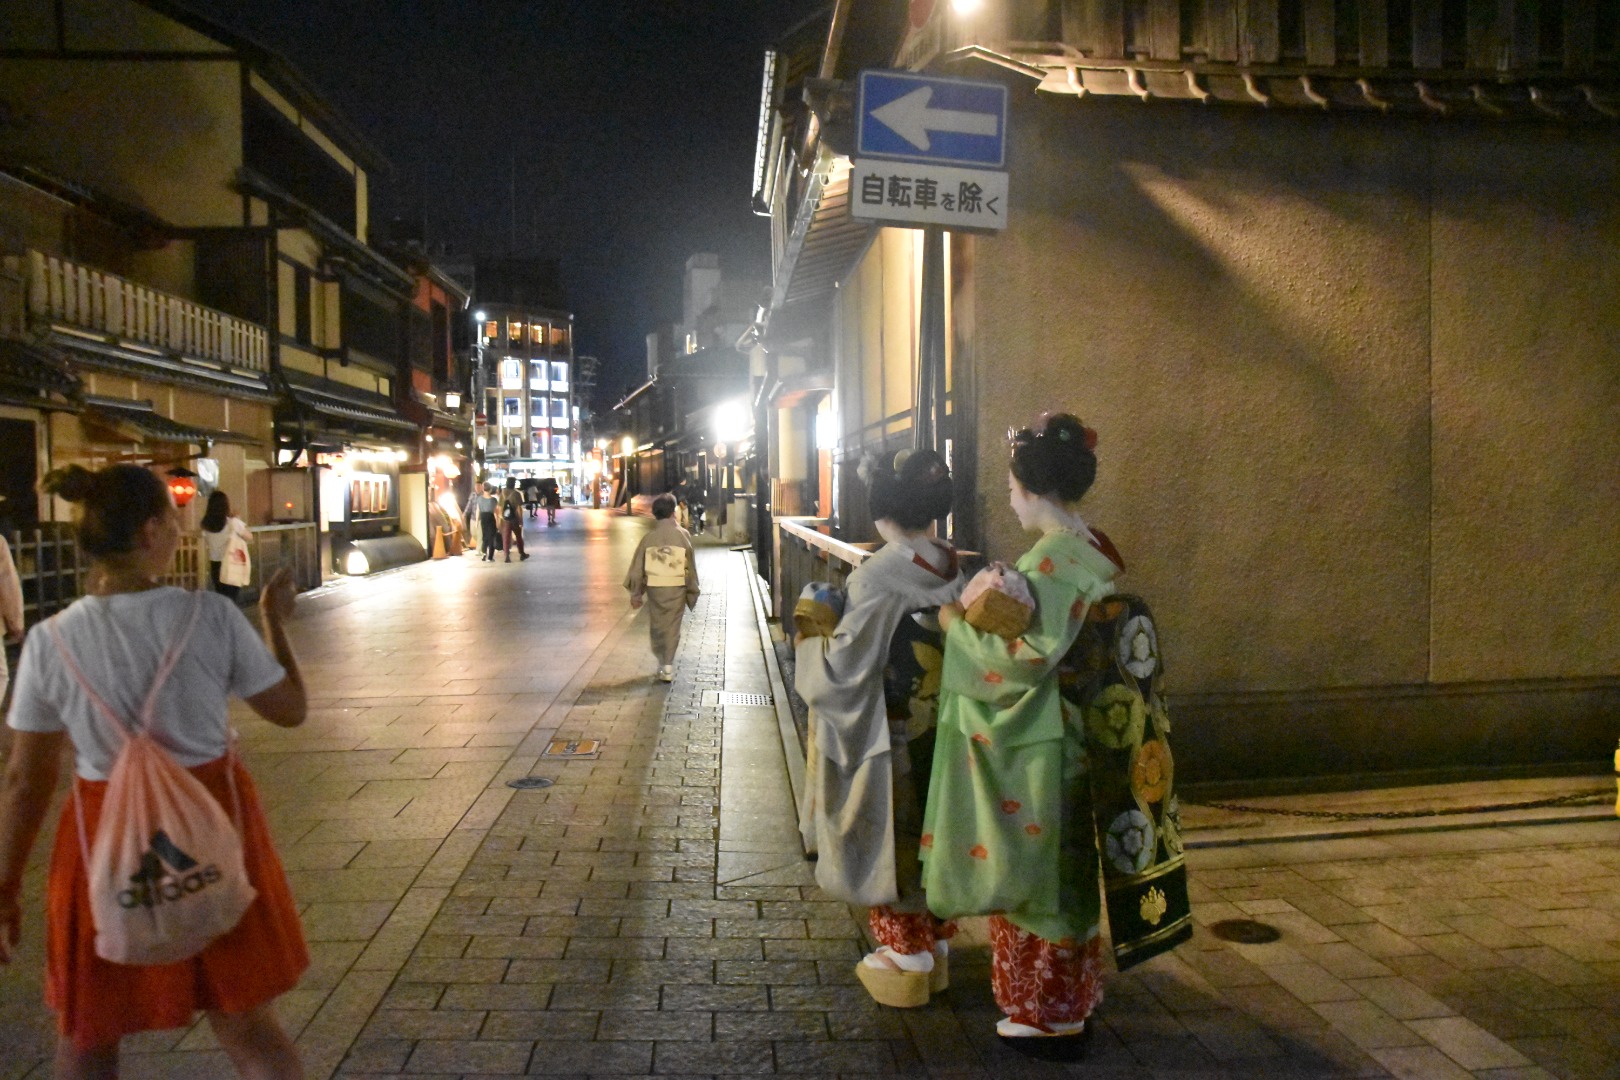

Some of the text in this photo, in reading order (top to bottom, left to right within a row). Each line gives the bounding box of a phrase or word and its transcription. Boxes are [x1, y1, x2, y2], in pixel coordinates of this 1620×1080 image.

[862, 173, 999, 215] 自転車を除く
[117, 863, 222, 909] adas
